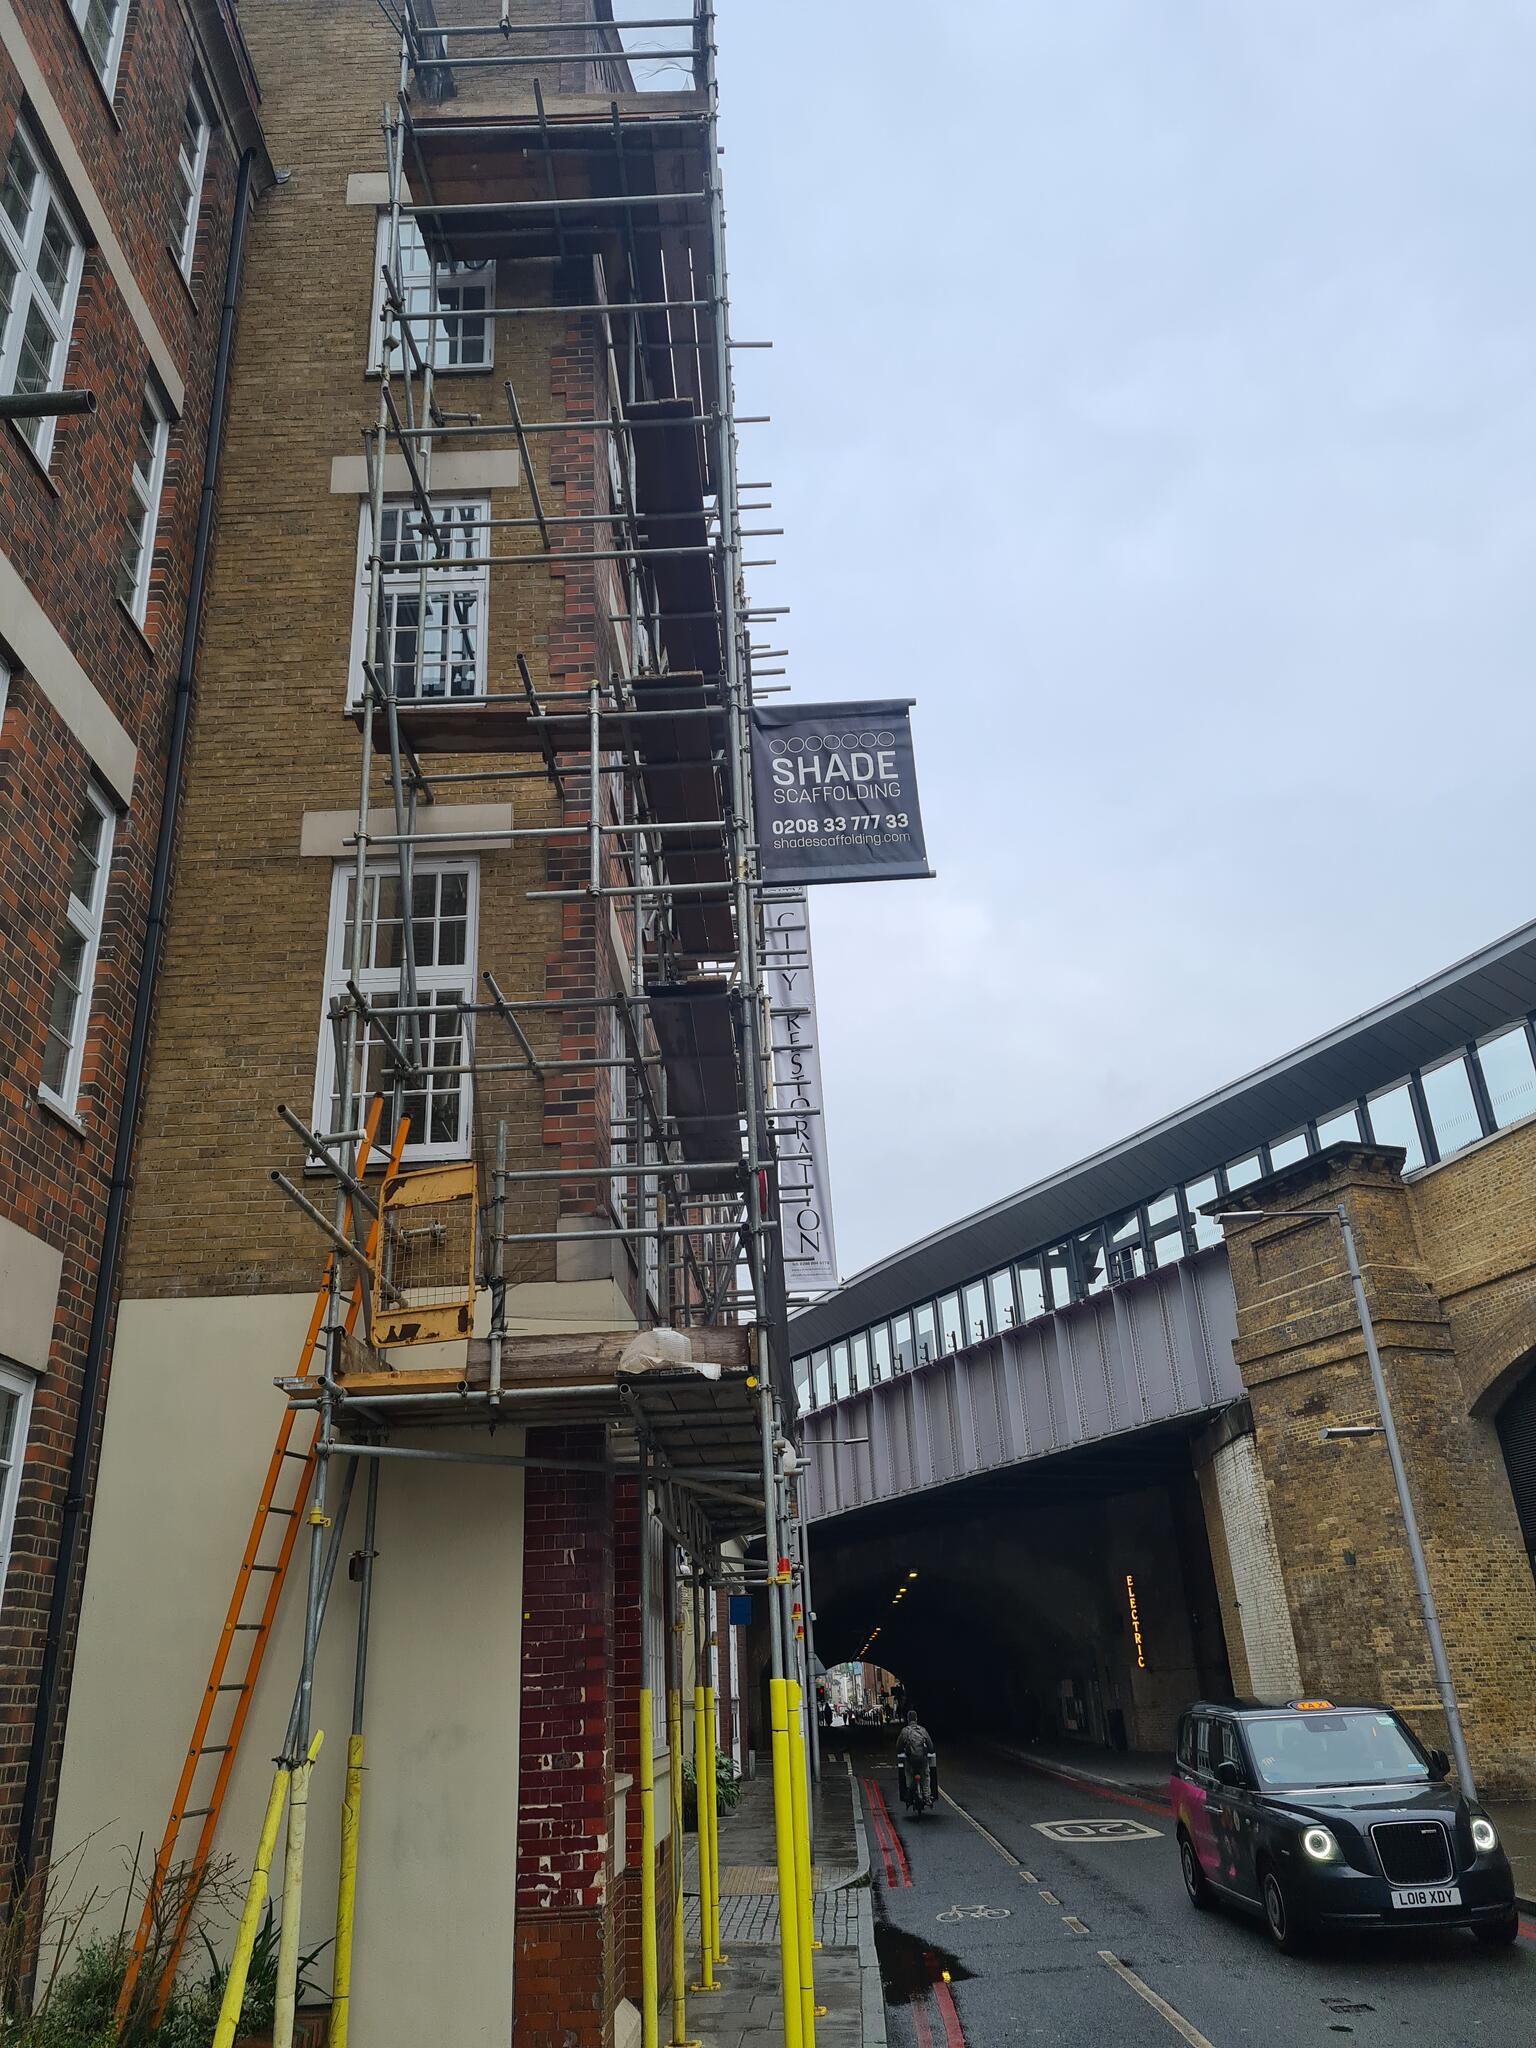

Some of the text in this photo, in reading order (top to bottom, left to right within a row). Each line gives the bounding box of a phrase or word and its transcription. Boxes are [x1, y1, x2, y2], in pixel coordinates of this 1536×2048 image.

[772, 751, 899, 786] SHADE
[773, 782, 901, 804] SCAFFOLDING
[772, 813, 909, 835] 0208 33 777 33
[773, 832, 911, 849] shadescaffolding.com
[1126, 1575, 1145, 1668] ELECTRIC
[1055, 1823, 1137, 1837] 20
[1399, 1890, 1452, 1906] LO18 XDY
